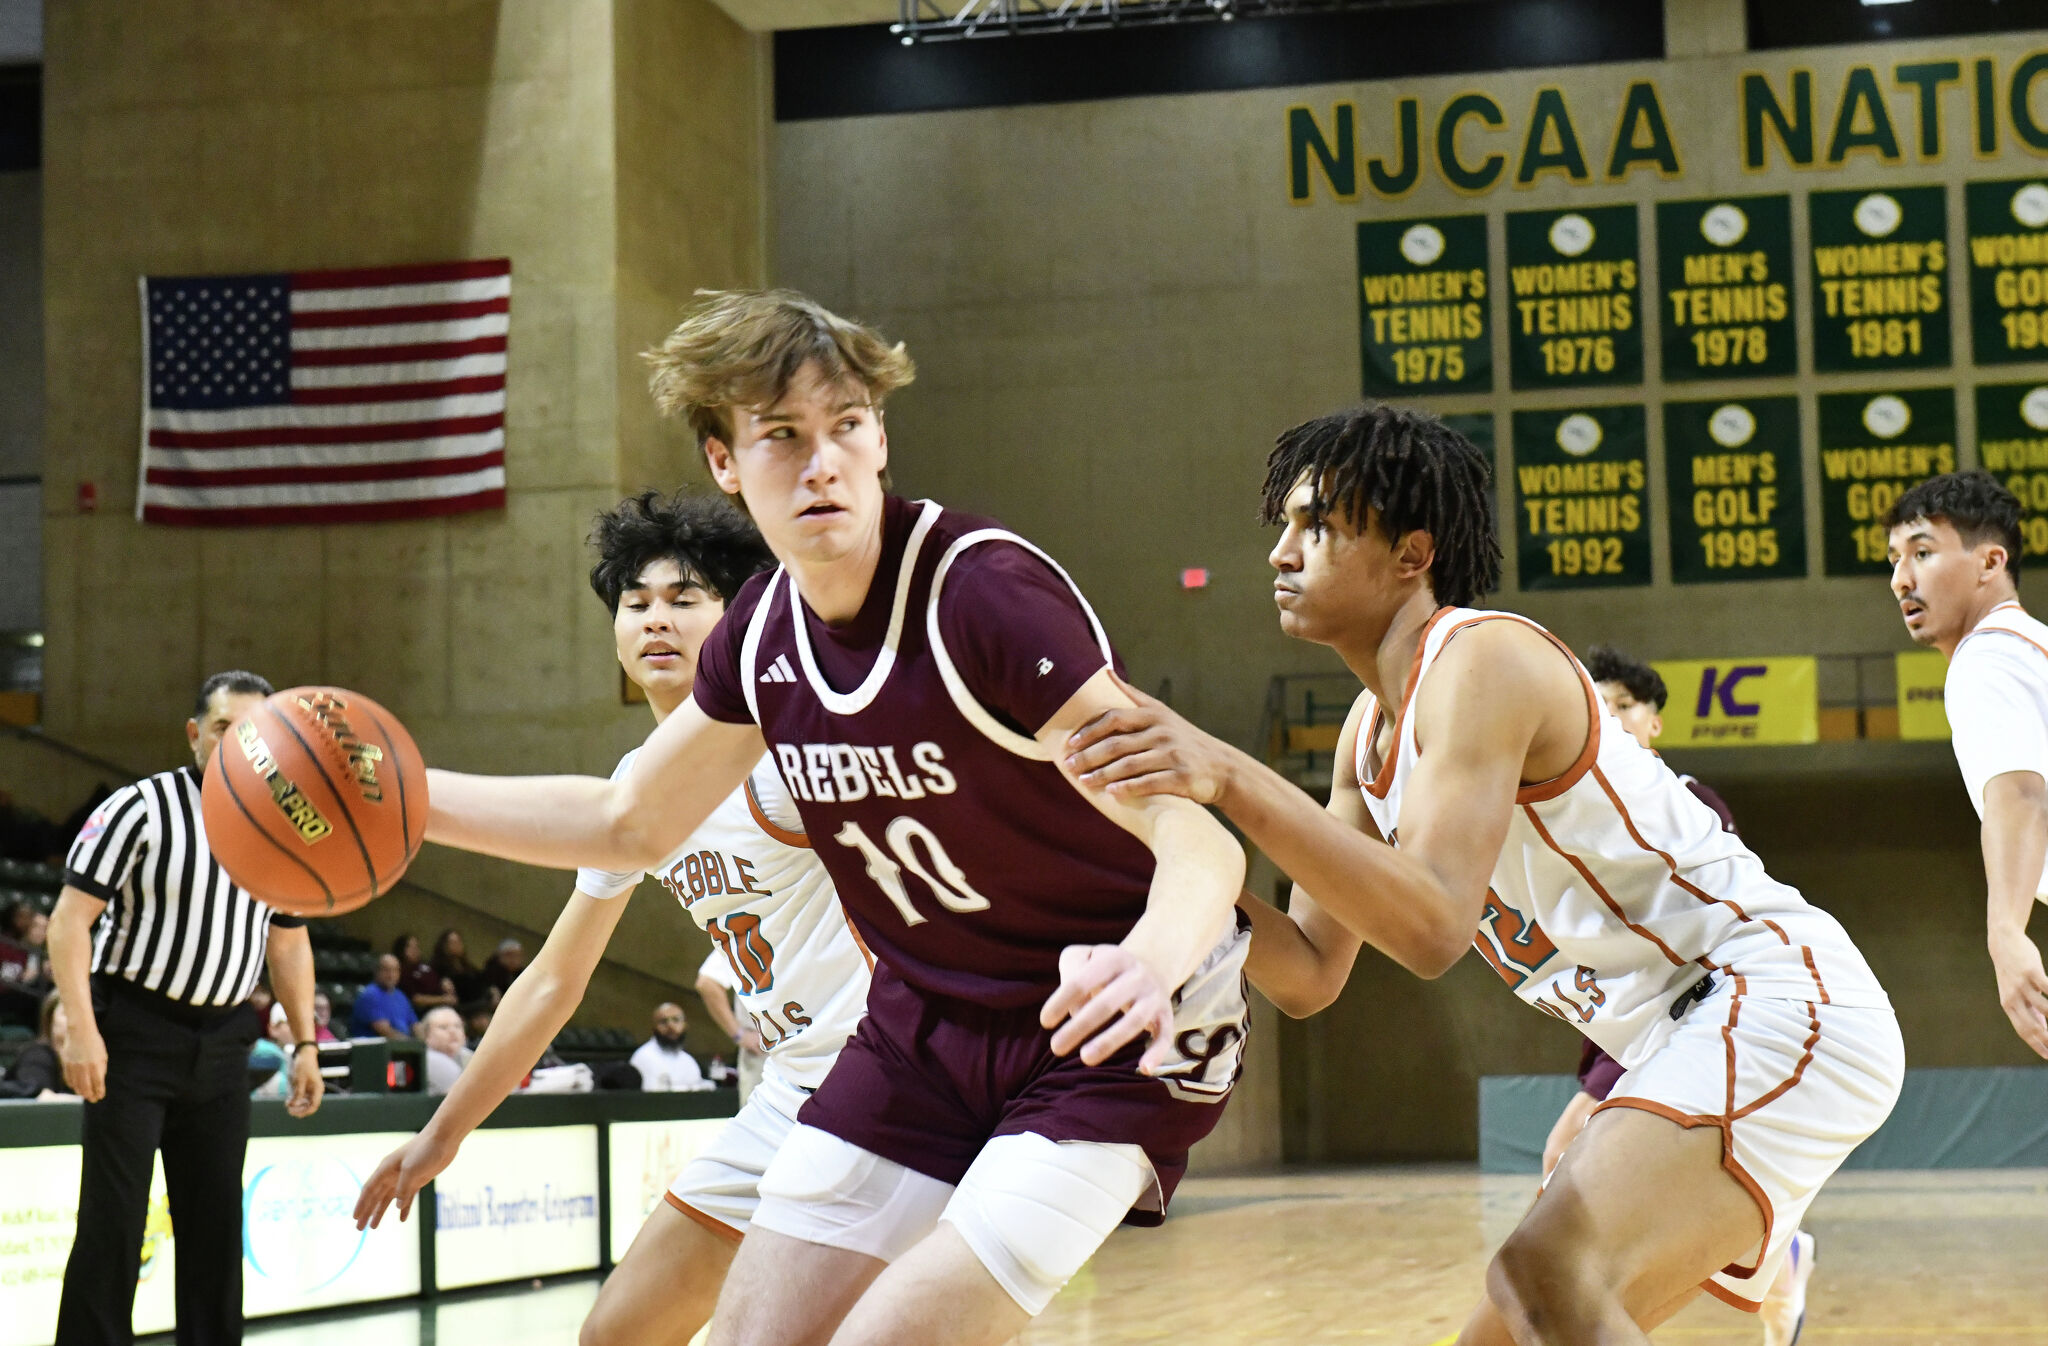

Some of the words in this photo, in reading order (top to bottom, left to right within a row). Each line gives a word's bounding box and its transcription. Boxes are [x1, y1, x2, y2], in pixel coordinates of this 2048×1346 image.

[1287, 80, 1682, 204] NJCAA
[1511, 259, 1637, 296] WOMEN'S
[1684, 251, 1768, 285] MEN'S
[1815, 240, 1946, 277] WOMEN'S
[1363, 268, 1486, 306] WOMEN'S
[1669, 283, 1788, 326] TENNIS
[1820, 275, 1943, 318] TENNIS
[1369, 302, 1483, 344] TENNIS
[1516, 293, 1633, 336] TENNIS
[1540, 336, 1616, 376] 1976
[1691, 326, 1769, 367] 1978
[1846, 319, 1923, 358] 1981
[1392, 345, 1466, 384] 1975
[1518, 459, 1645, 496] WOMEN'S
[1692, 451, 1777, 486] MEN'S
[1823, 443, 1955, 480] WOMEN'S
[1524, 494, 1641, 536] TENNIS
[1693, 487, 1777, 528] GOLF
[1545, 536, 1624, 576] 1992
[1700, 529, 1779, 568] 1995
[775, 741, 957, 803] REBELS
[834, 815, 991, 927] 10
[706, 911, 775, 997] 10
